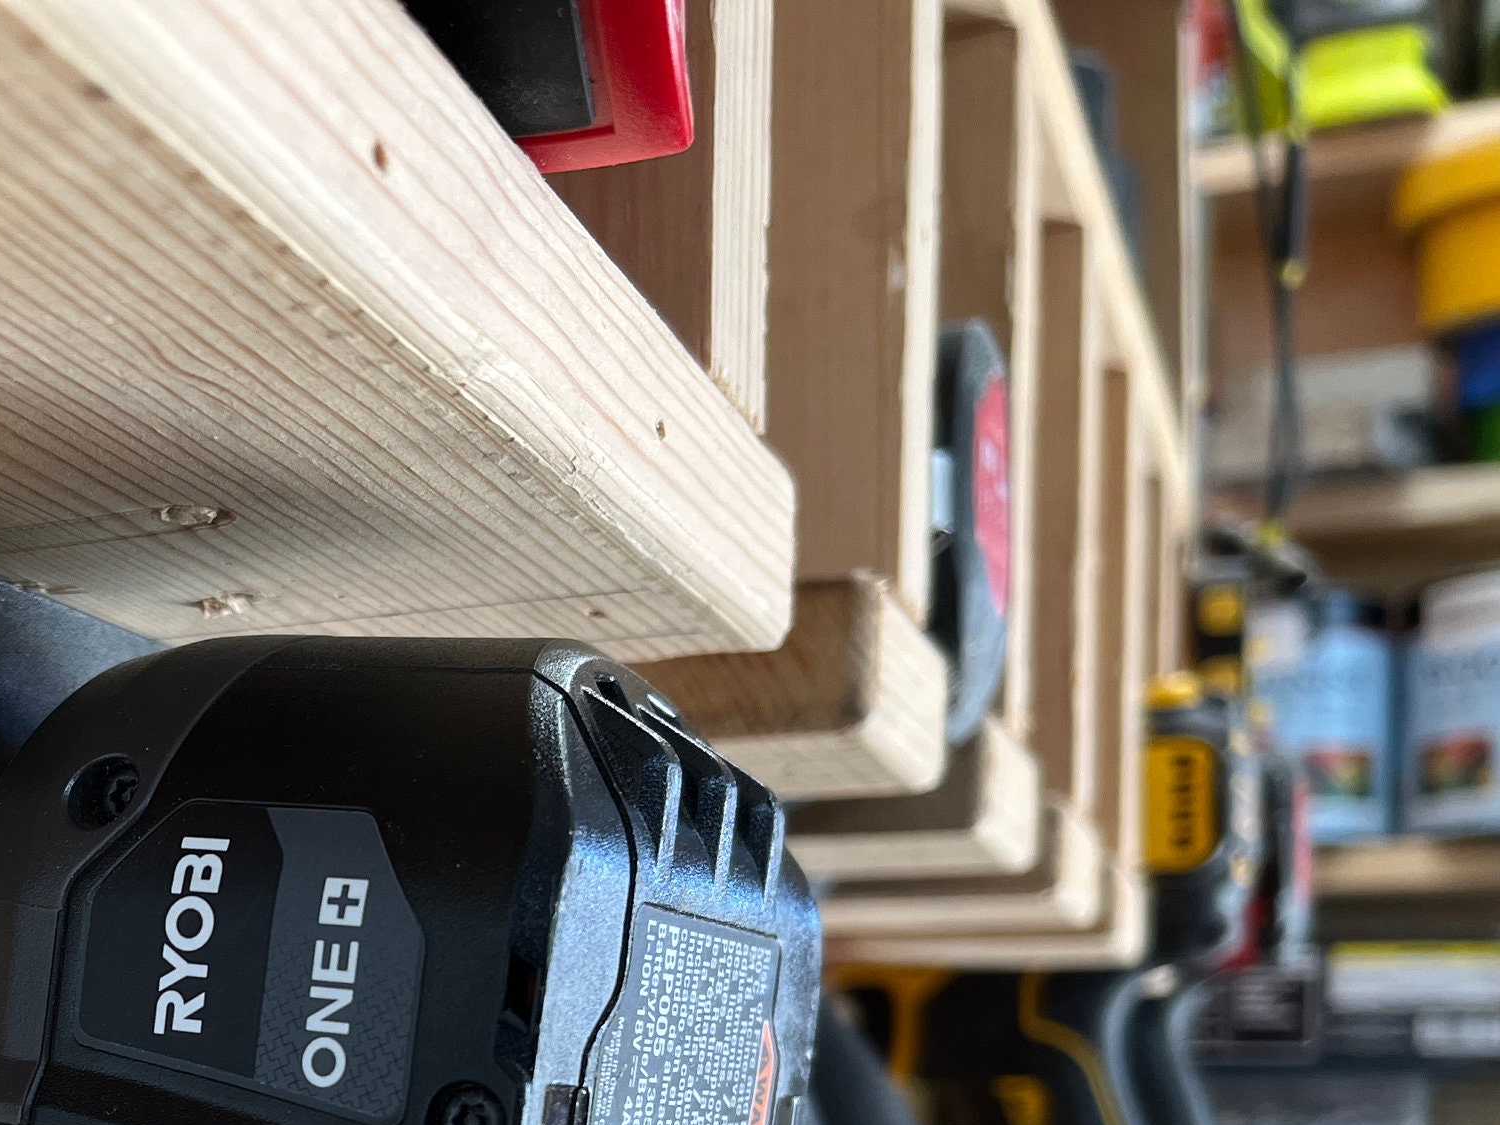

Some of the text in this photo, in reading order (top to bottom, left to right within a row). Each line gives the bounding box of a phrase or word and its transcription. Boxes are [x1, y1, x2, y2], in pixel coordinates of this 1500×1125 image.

[154, 837, 230, 1034] RYOBI
[638, 918, 657, 997] LI-ION
[670, 927, 689, 1017] cuando
[677, 928, 698, 1032] indicado
[686, 930, 705, 1027] incinere
[709, 935, 721, 970] les
[731, 941, 743, 982] des
[631, 1004, 646, 1050] 18V
[651, 924, 680, 1057] PBP005
[688, 993, 706, 1063] lluvia,
[605, 1016, 624, 1117] Made China
[702, 1006, 720, 1084] Retirer
[729, 1019, 747, 1108] Remove
[735, 1006, 756, 1115] Incinerate
